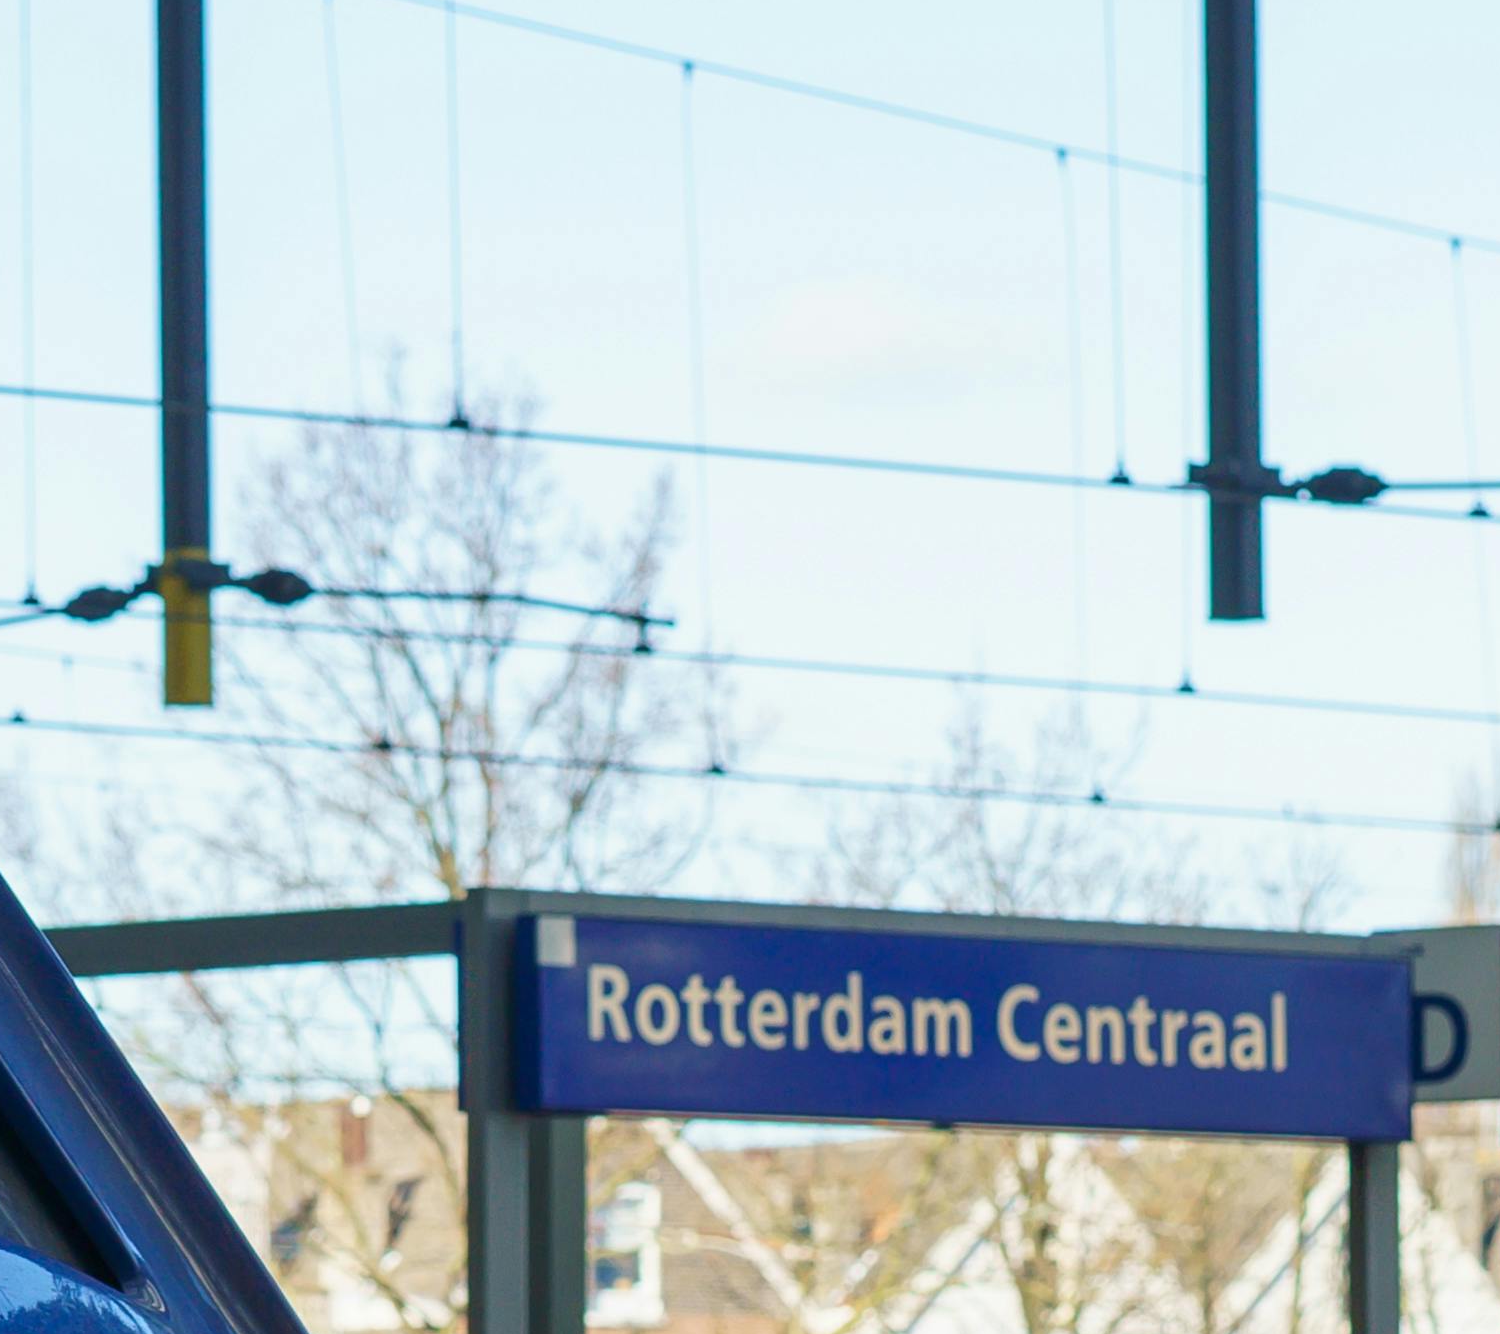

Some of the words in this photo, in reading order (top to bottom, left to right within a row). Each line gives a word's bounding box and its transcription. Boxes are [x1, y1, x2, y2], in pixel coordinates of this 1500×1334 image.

[587, 964, 974, 1058] Rotterdam
[997, 983, 1289, 1072] Centraal
[1411, 990, 1469, 1086] D
